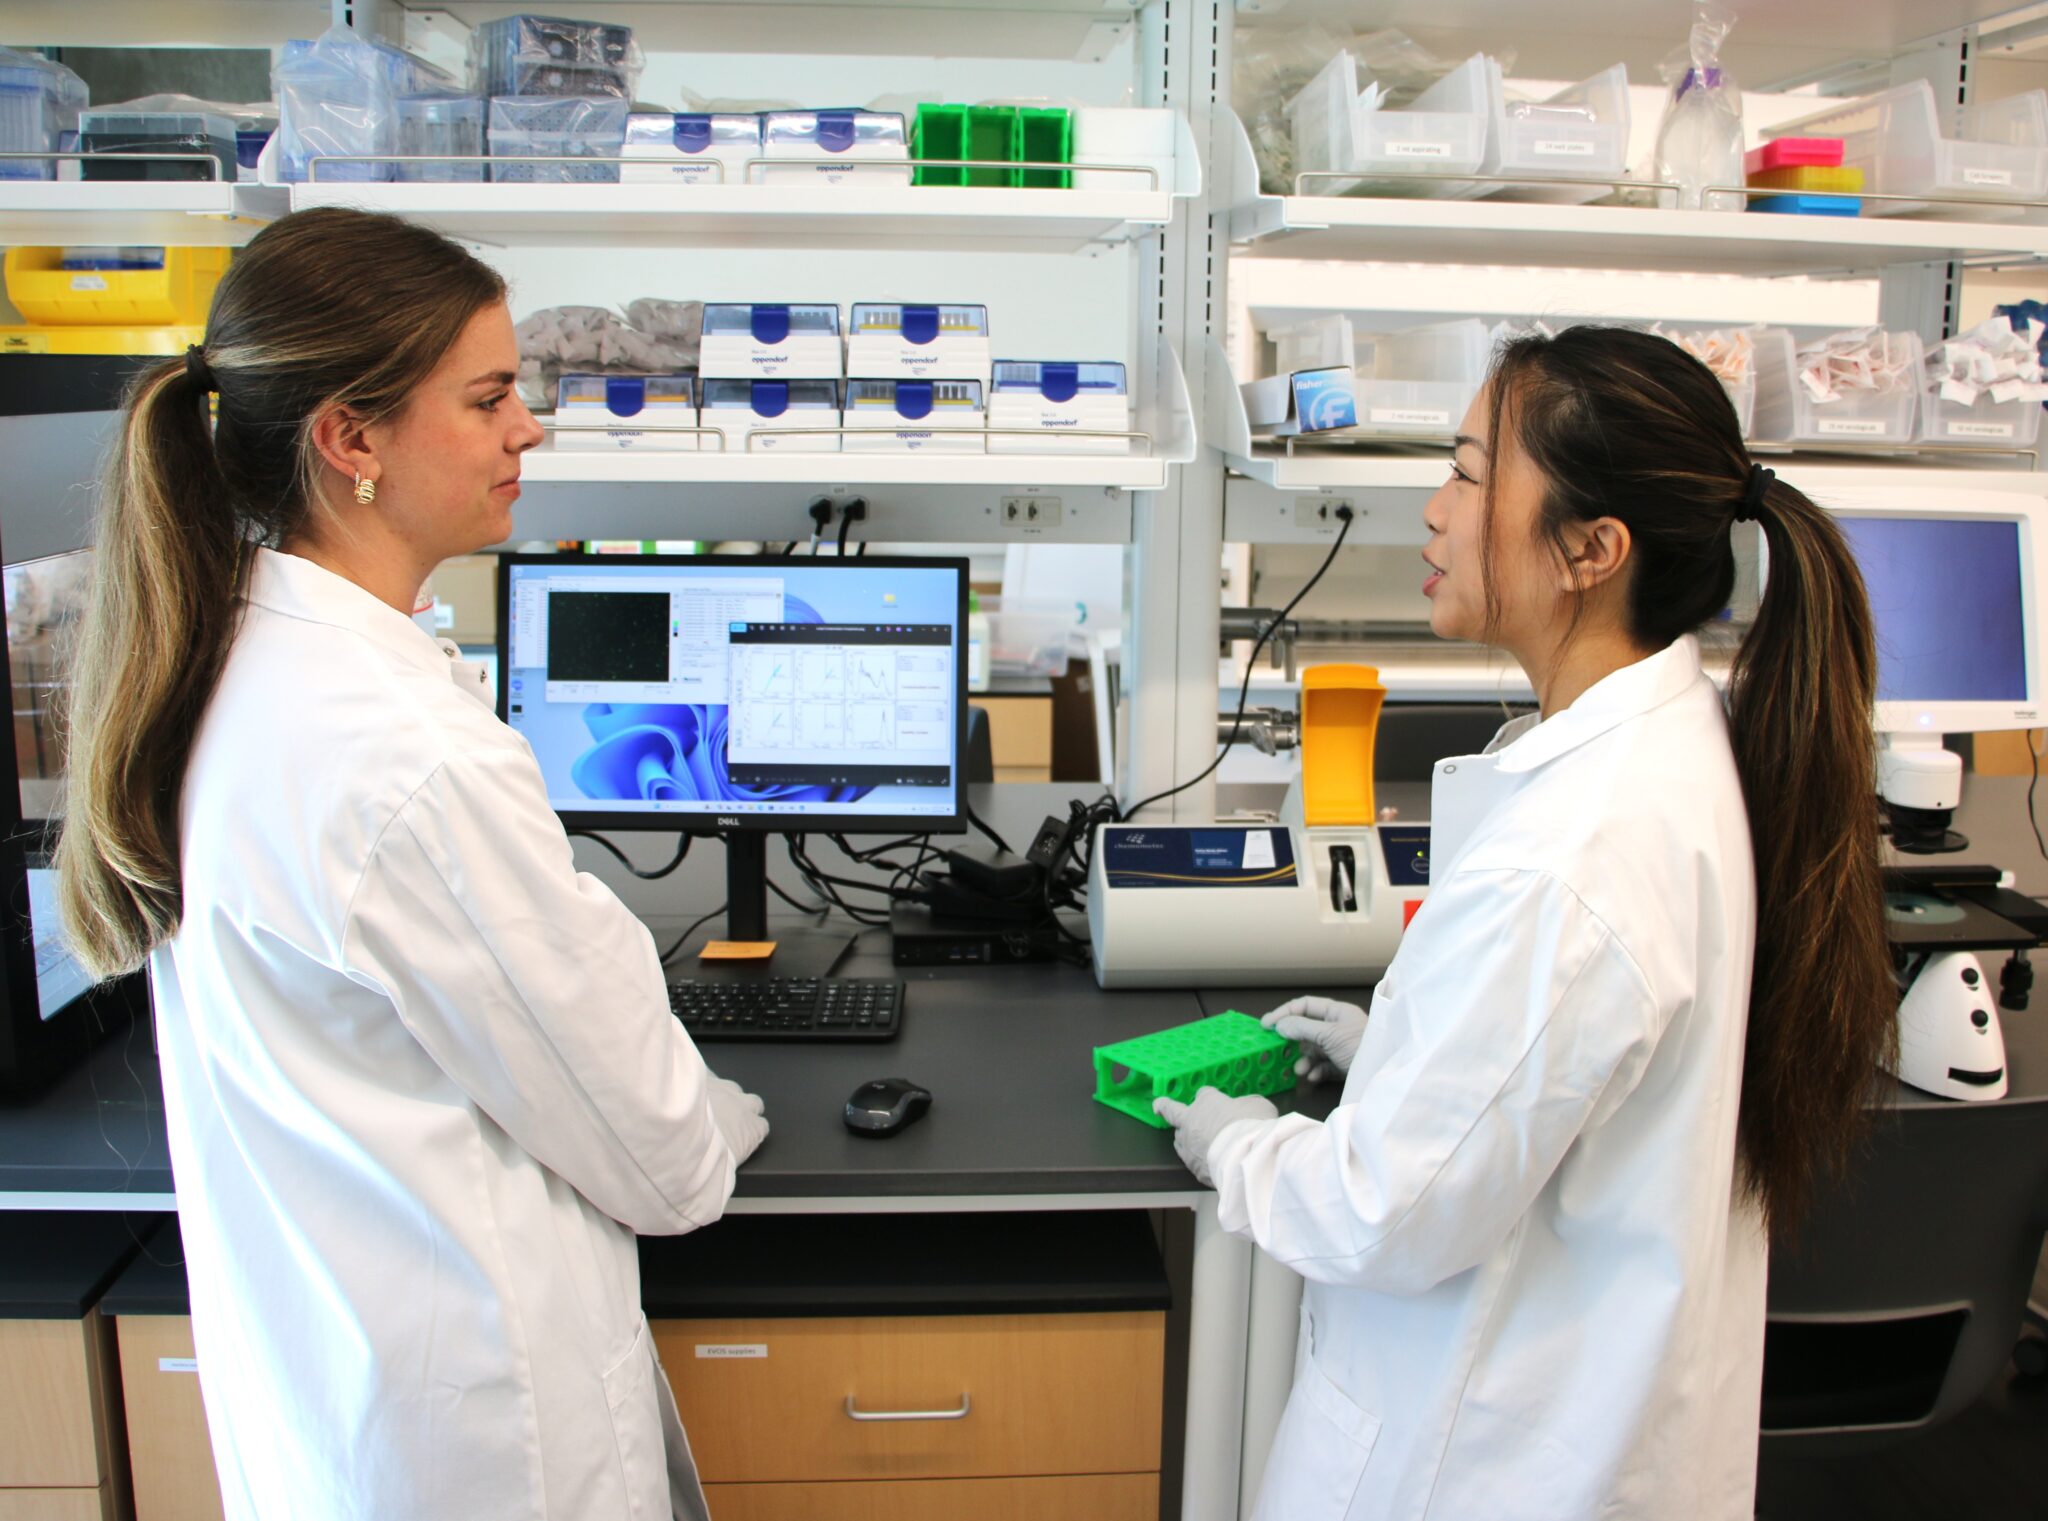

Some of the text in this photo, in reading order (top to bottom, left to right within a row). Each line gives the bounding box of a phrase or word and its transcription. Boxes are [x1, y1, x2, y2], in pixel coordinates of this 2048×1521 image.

[672, 165, 710, 175] eppendorf
[816, 164, 854, 173] eppendorf
[752, 356, 788, 365] eppendorf
[901, 356, 938, 366] eppendorf
[1041, 419, 1078, 428] eppendorf
[717, 817, 740, 826] DELL
